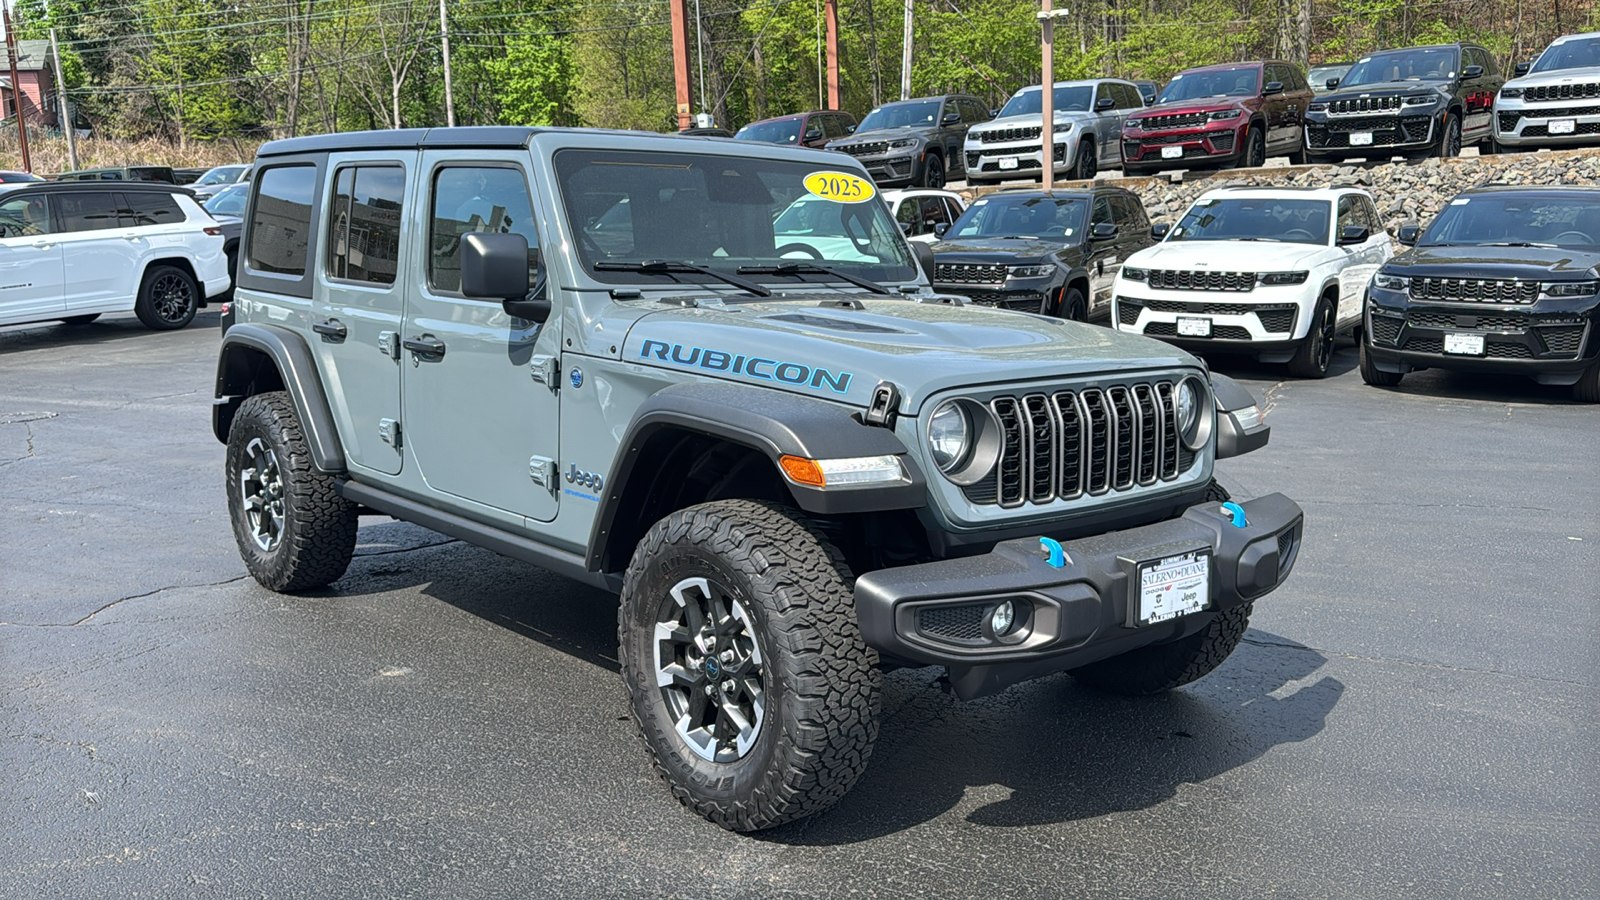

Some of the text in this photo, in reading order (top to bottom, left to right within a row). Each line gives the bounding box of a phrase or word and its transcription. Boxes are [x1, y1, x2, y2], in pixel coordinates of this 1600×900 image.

[818, 177, 861, 196] 2025
[640, 338, 854, 394] RUBICON
[565, 462, 604, 494] Jeep
[1143, 563, 1206, 586] SALERNO DUANE
[1181, 592, 1197, 602] Jeep
[1148, 612, 1176, 624] SALERNO
